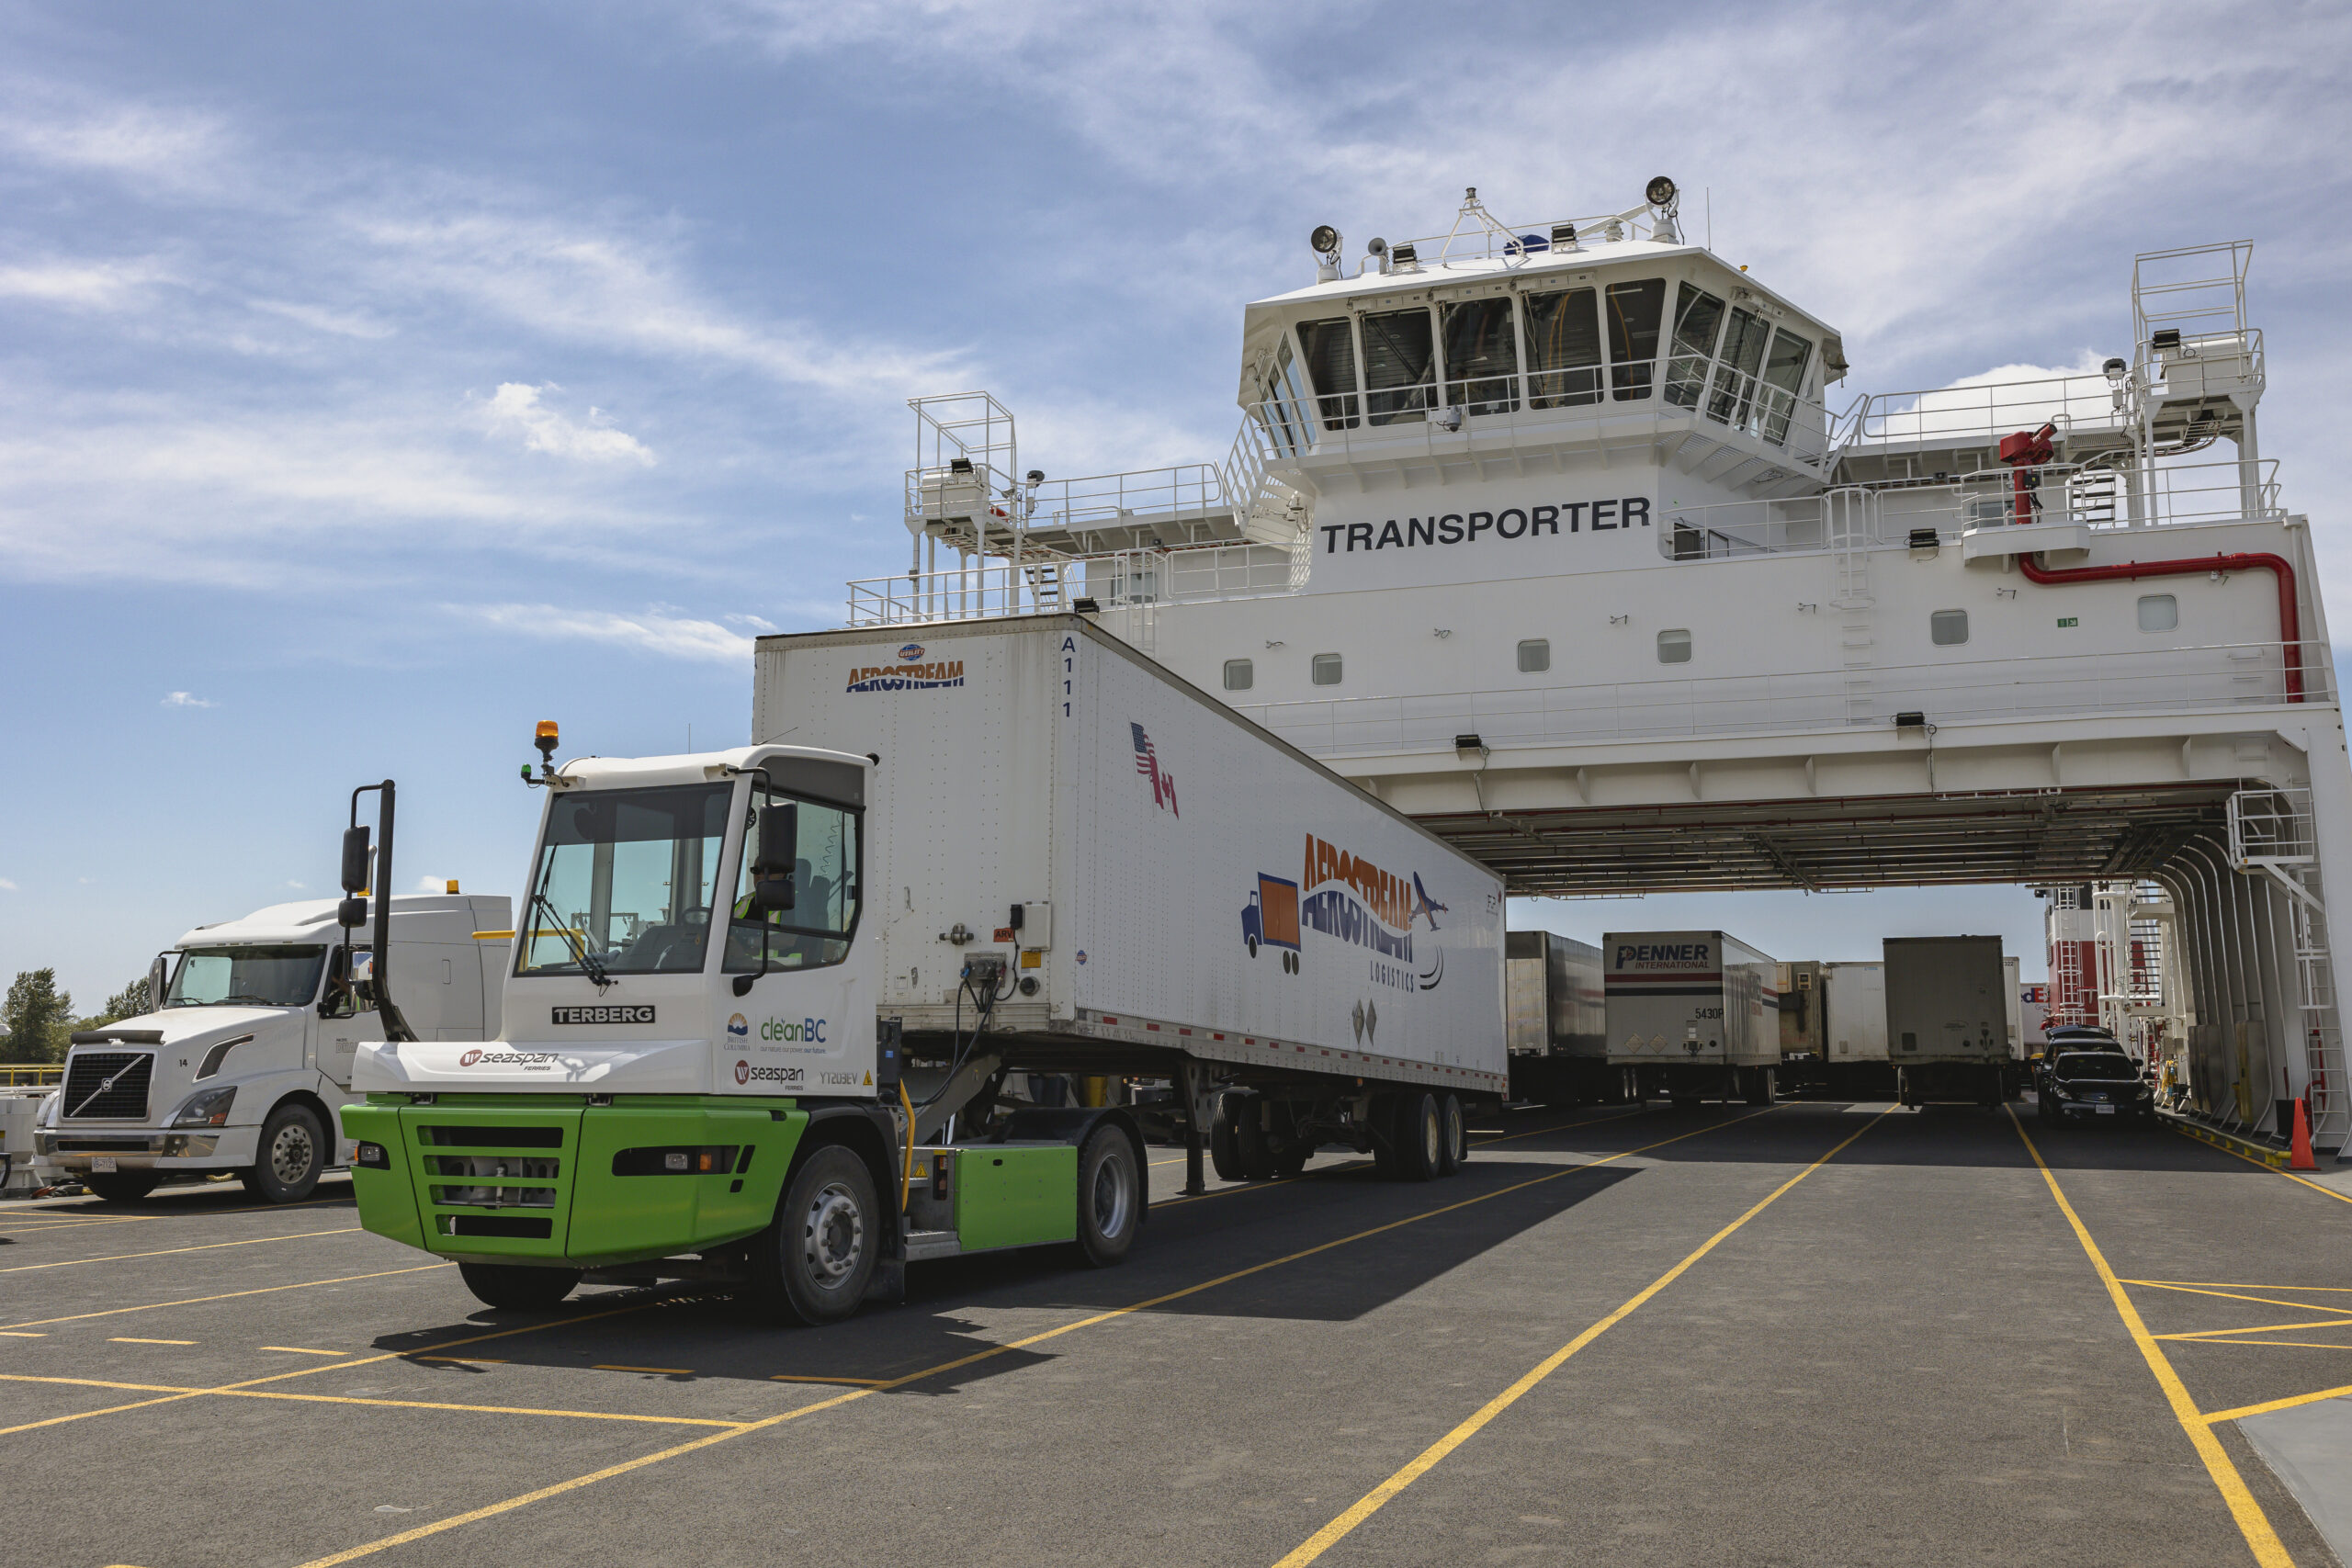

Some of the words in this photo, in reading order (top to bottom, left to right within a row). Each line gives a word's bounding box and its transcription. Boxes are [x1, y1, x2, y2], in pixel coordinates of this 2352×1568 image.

[1320, 497, 1651, 554] TRANSPORTER
[899, 649, 924, 657] UTILITY
[846, 660, 964, 693] AEROSTREAM
[1302, 832, 1413, 964] AEROSTREAM
[995, 930, 1012, 938] ARV
[1615, 944, 1709, 969] PENNER
[1634, 961, 1710, 969] INTERNATIONAL
[1370, 960, 1414, 994] LOGISTICS
[554, 1007, 653, 1023] TERBERG
[760, 1016, 827, 1043] cleanBC
[723, 1043, 751, 1051] COLUMBIA
[727, 1035, 749, 1043] BRITISH
[179, 1059, 188, 1067] 14
[480, 1053, 560, 1065] seaspan
[750, 1066, 804, 1084] seaspan
